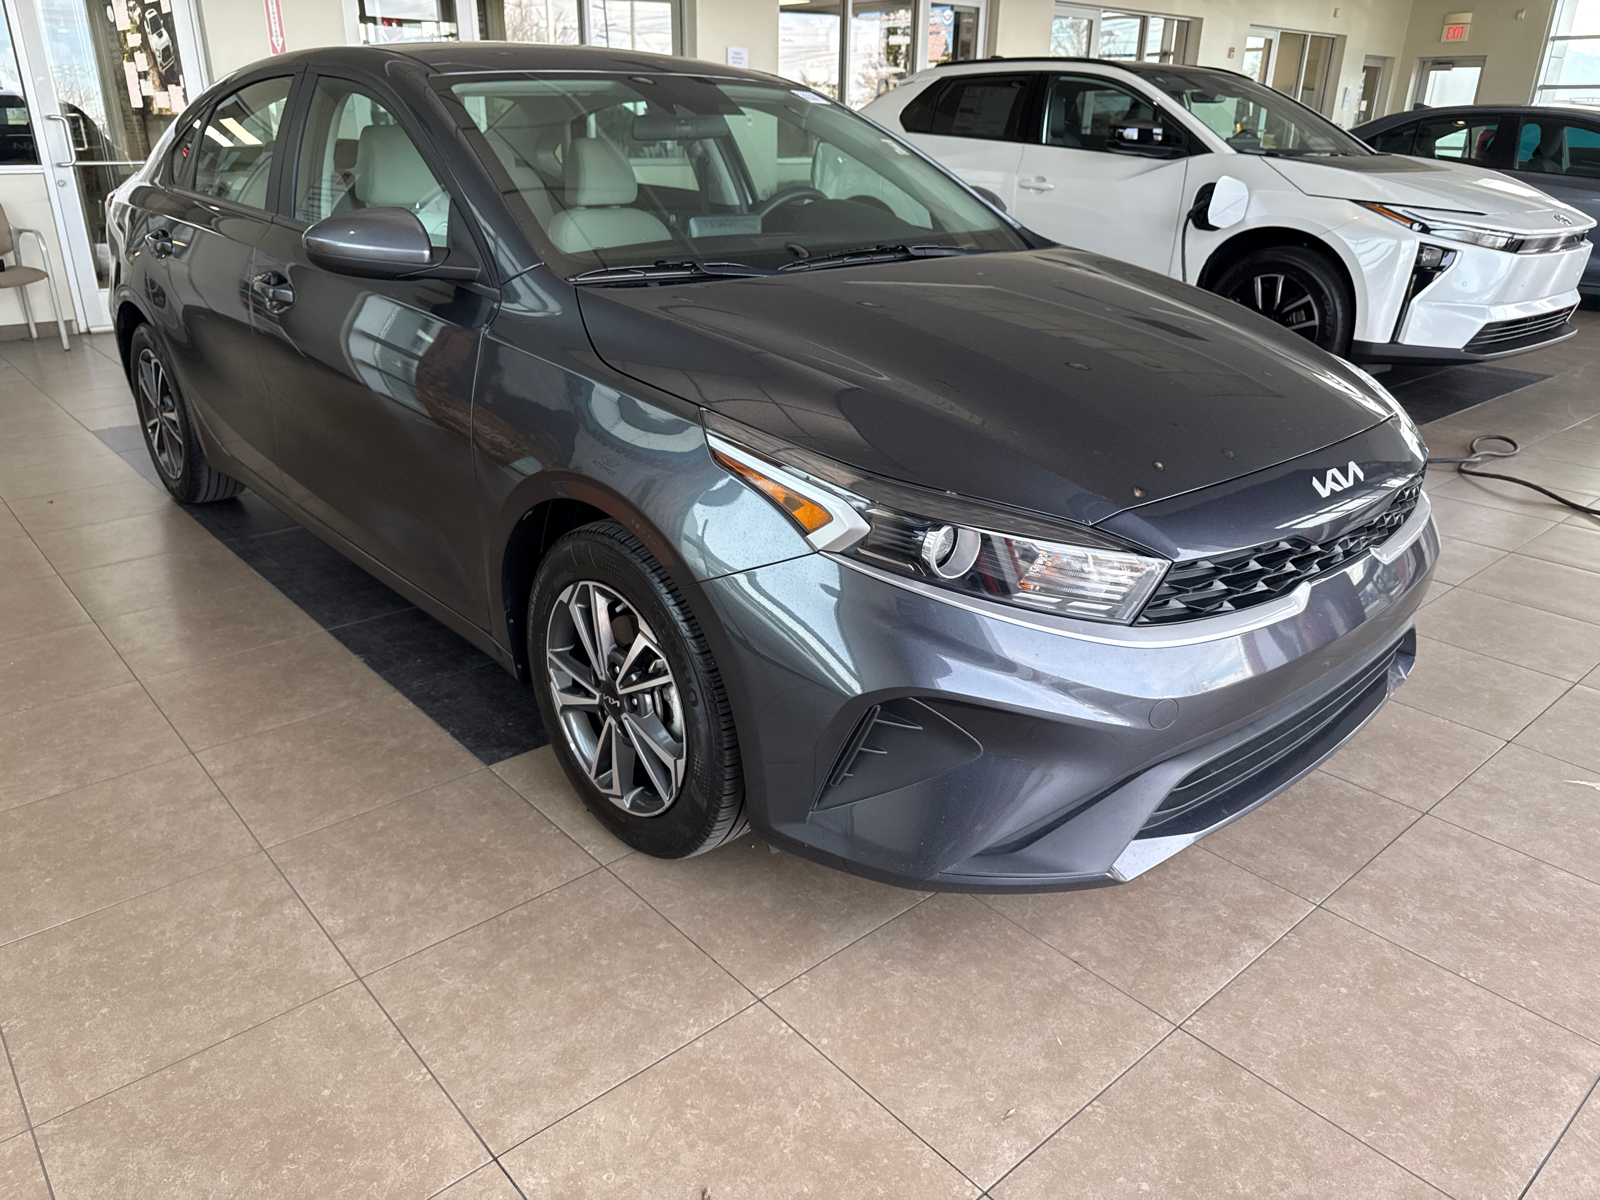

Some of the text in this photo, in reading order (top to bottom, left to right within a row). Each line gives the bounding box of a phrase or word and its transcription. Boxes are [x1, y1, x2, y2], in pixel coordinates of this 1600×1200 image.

[1446, 26, 1465, 40] EXIT
[1312, 461, 1364, 498] KIA
[651, 600, 699, 708] KUMHO
